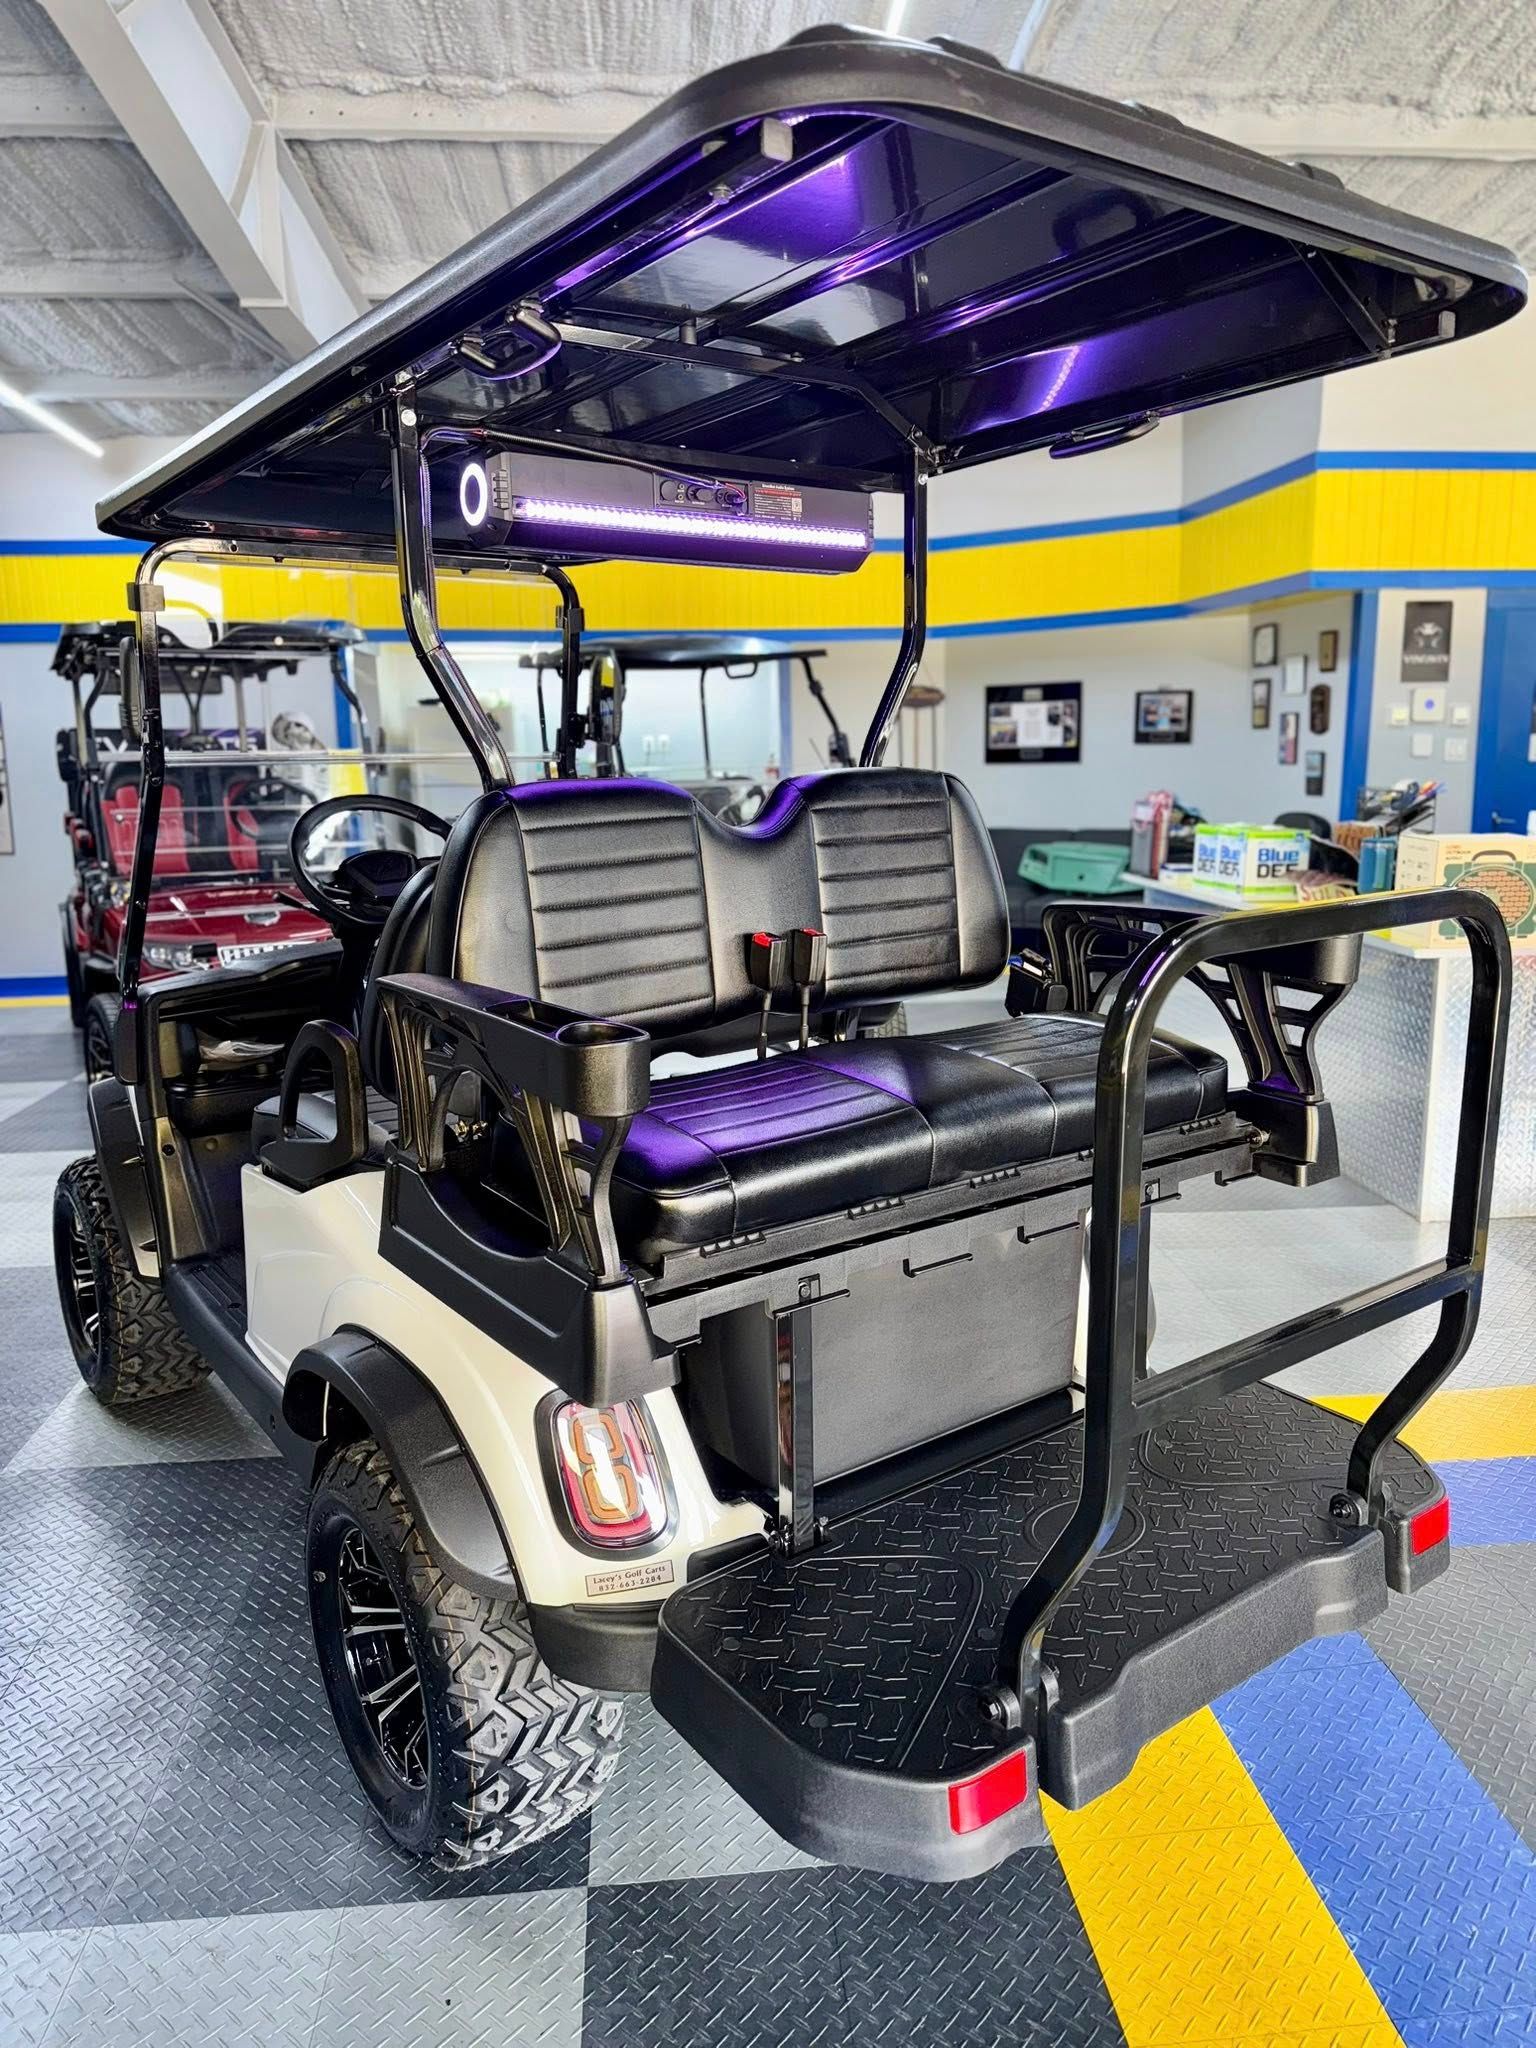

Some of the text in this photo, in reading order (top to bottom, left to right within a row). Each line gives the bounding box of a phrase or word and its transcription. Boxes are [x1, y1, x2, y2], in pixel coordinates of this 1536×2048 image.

[1258, 848, 1299, 862] Blue
[1257, 863, 1298, 878] DEF
[593, 1566, 665, 1585] Lacey's Golf Carts
